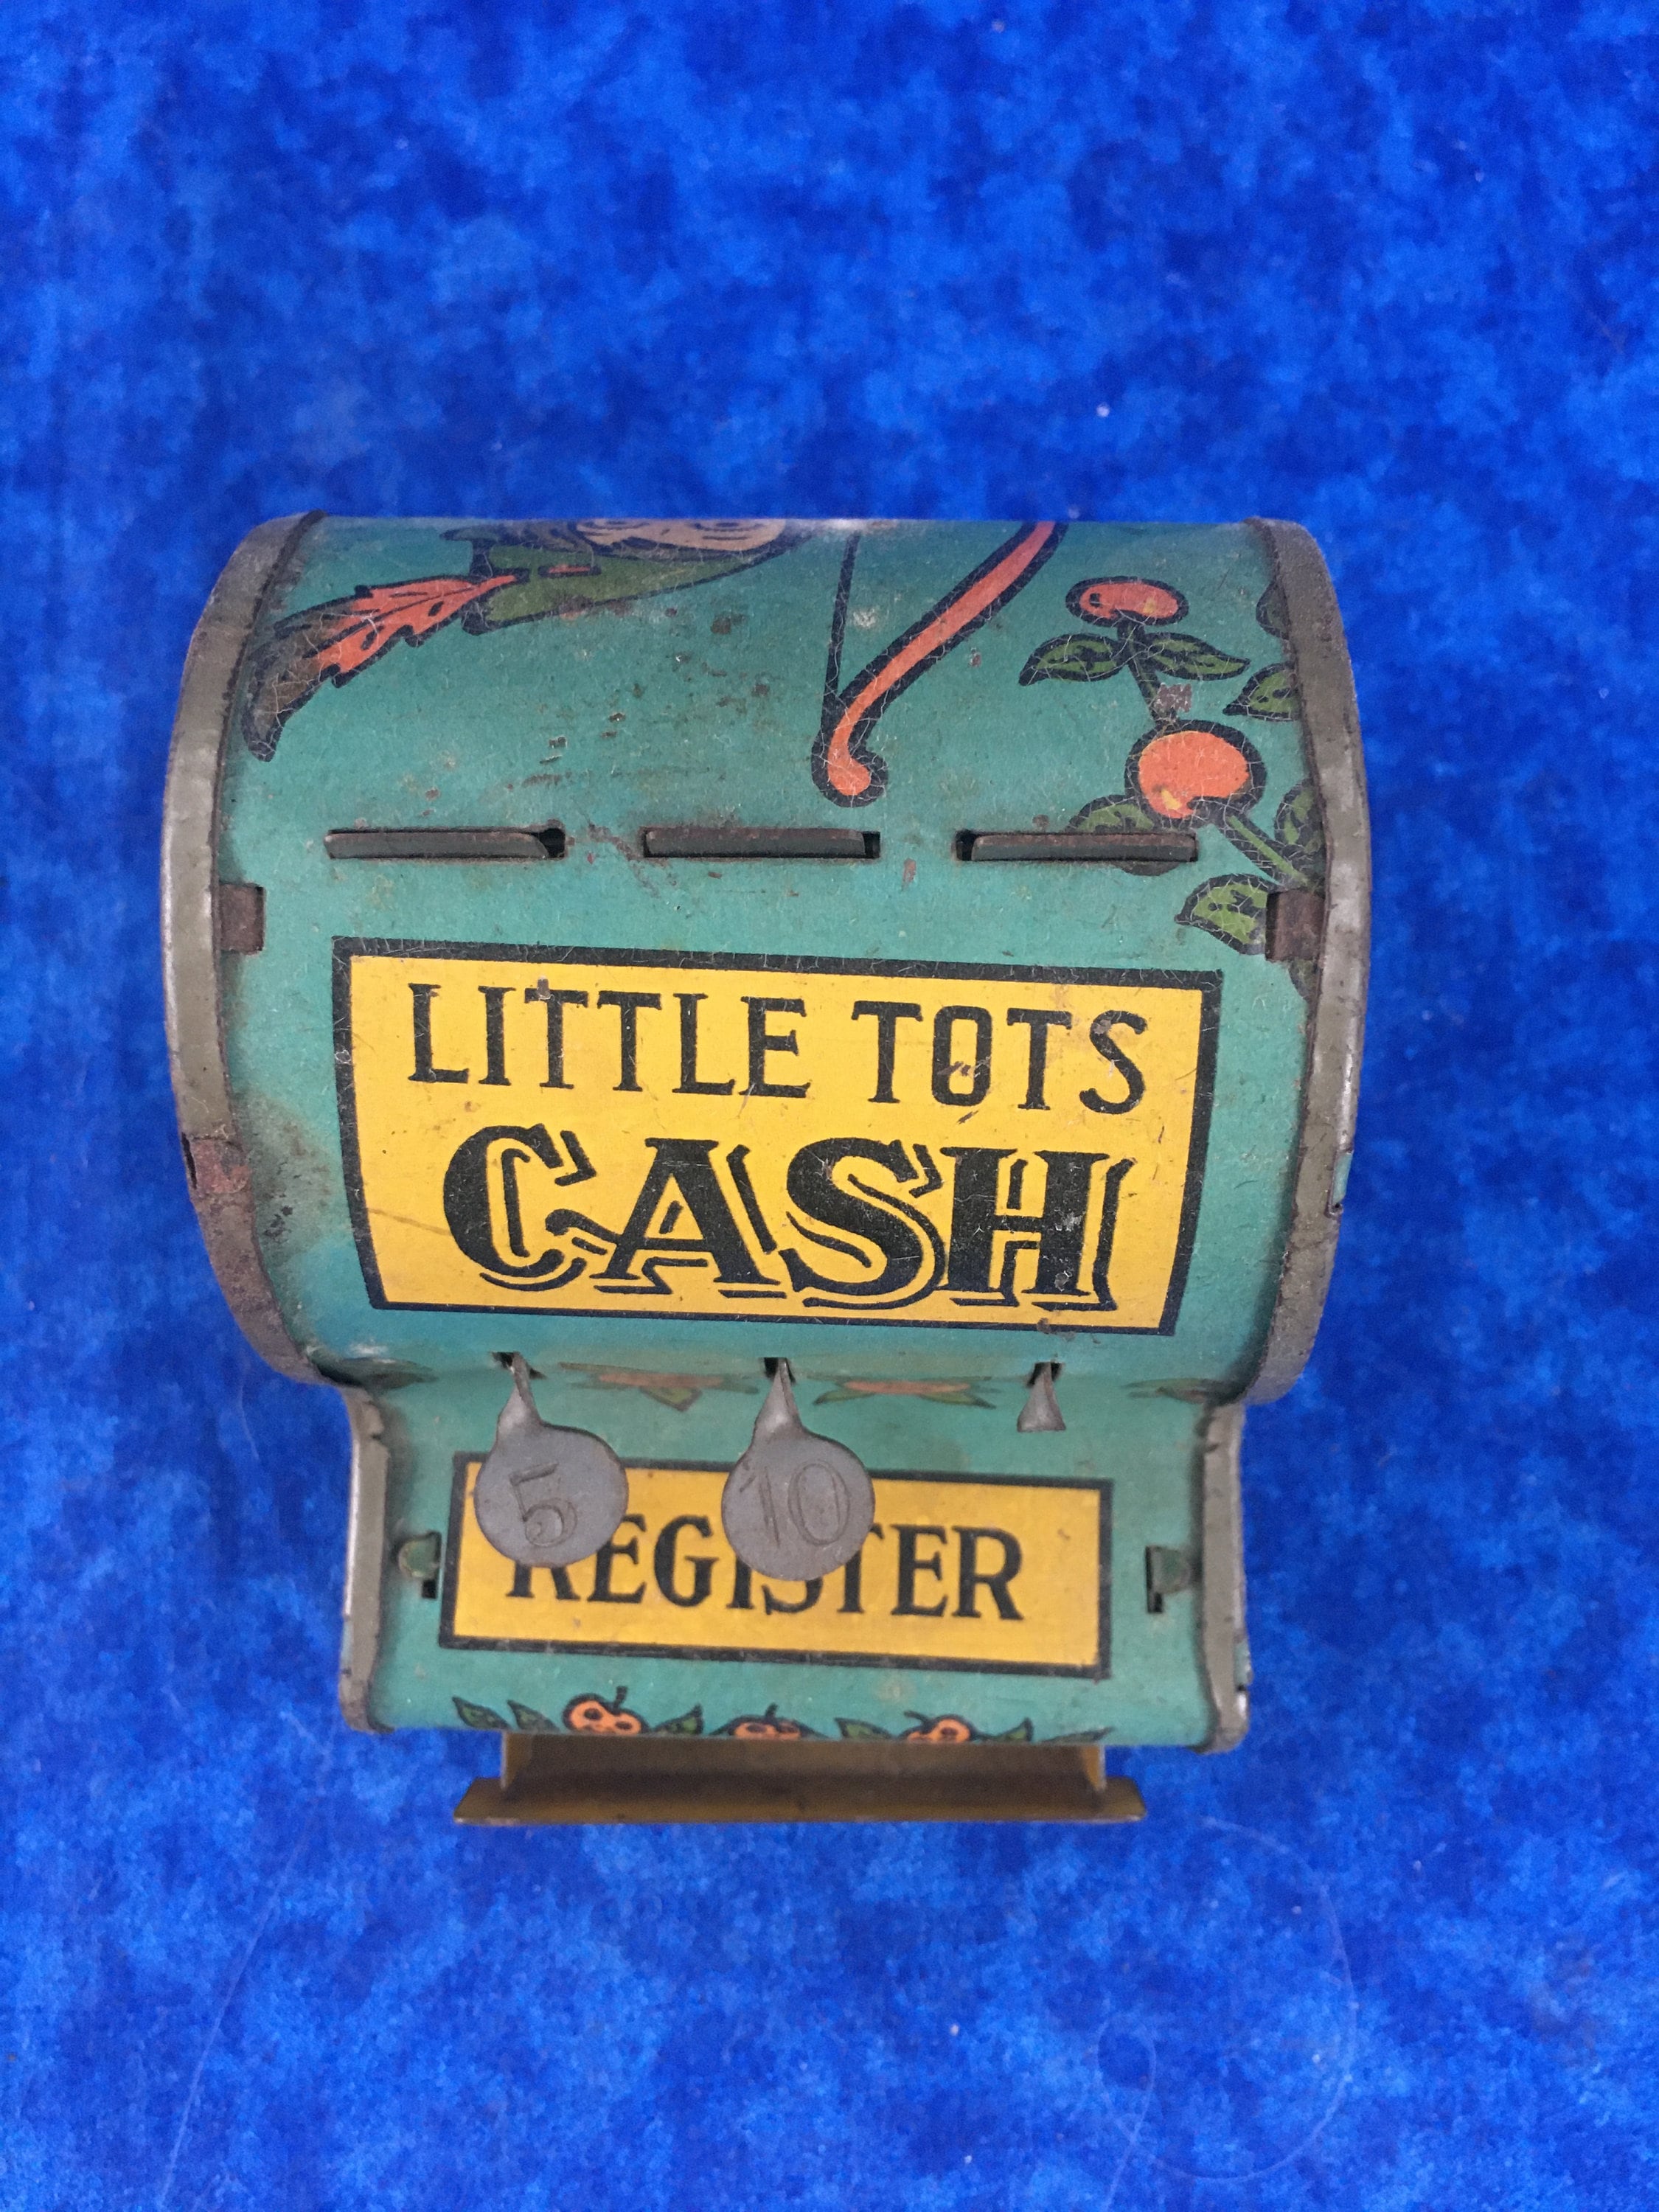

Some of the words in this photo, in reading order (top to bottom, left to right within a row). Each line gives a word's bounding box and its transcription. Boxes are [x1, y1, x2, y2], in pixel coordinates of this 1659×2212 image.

[407, 982, 811, 1099] LITTLE
[850, 1000, 1148, 1116] TOTS
[442, 1124, 1135, 1312] CASH
[509, 1463, 578, 1547] 5
[739, 1463, 851, 1548] 10
